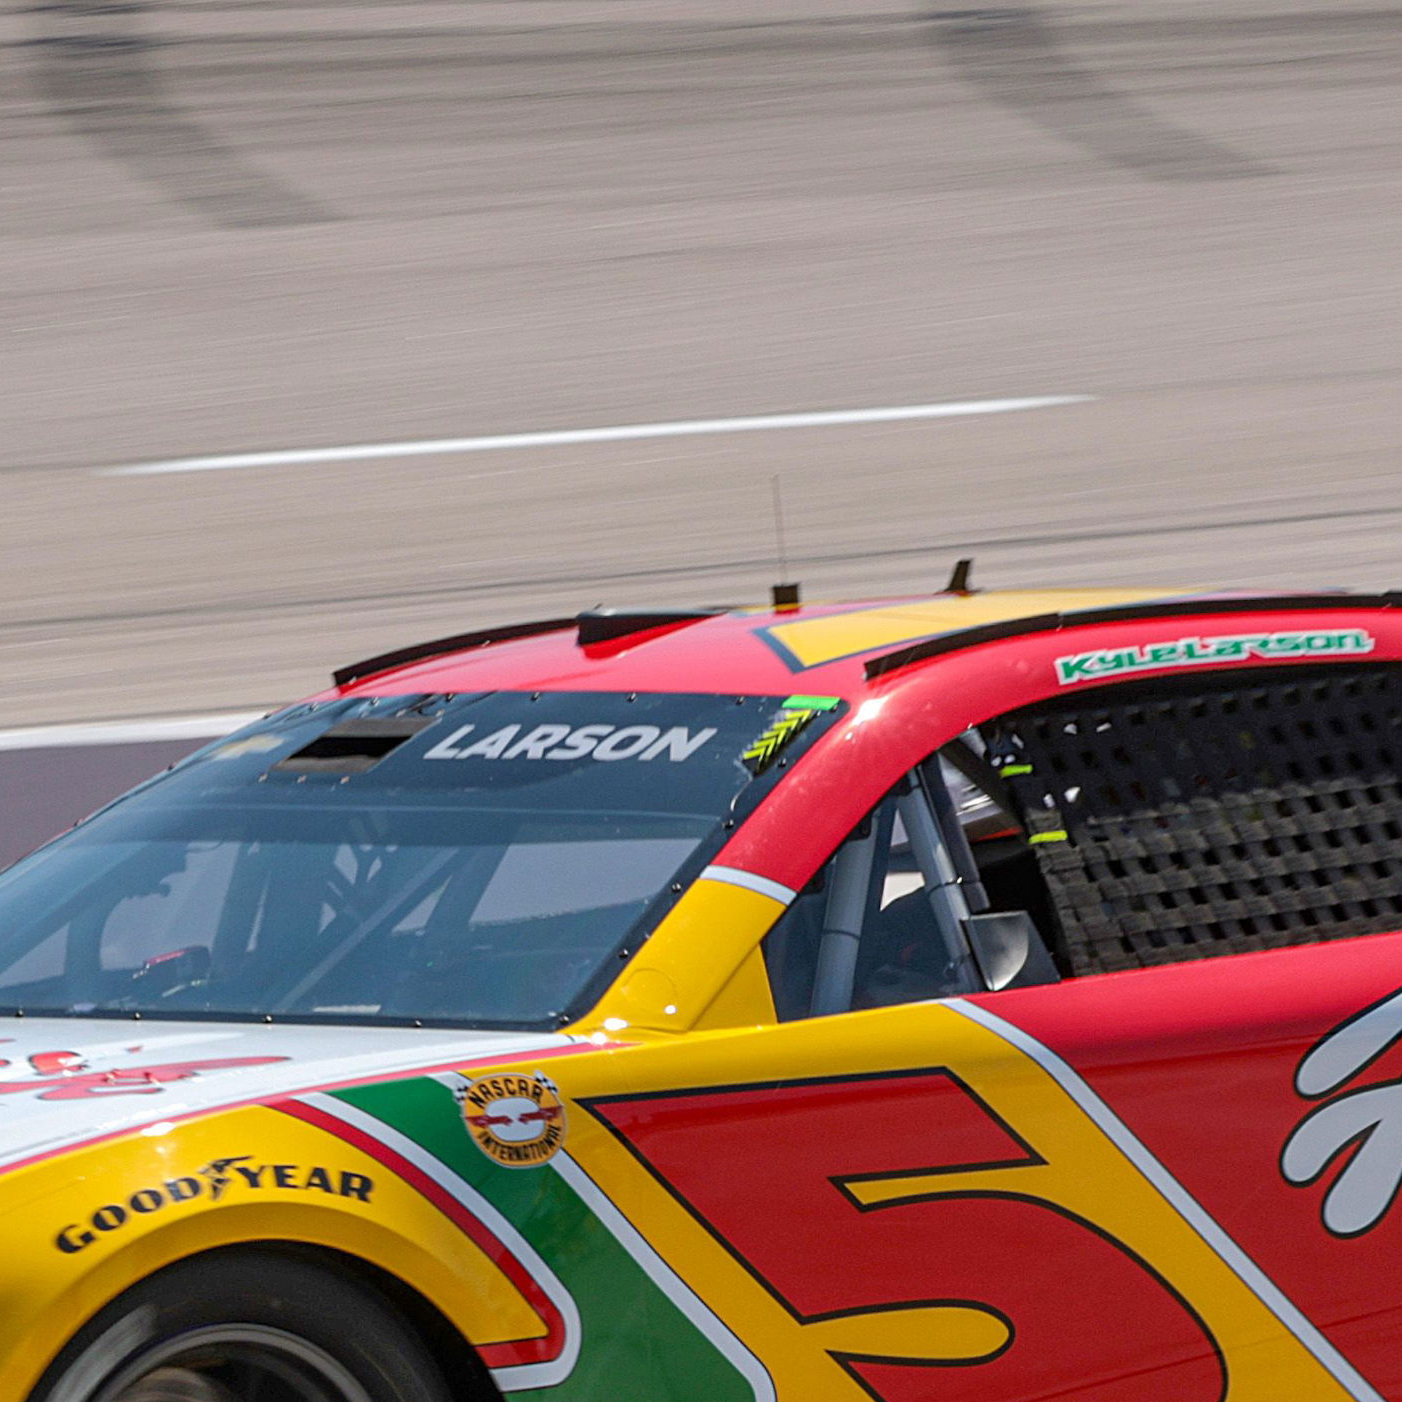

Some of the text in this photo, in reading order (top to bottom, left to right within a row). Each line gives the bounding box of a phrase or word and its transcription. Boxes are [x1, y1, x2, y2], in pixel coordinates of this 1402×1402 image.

[423, 724, 719, 762] LARSON
[467, 1078, 543, 1110] NASCAR
[55, 1155, 374, 1254] GOODYEAR
